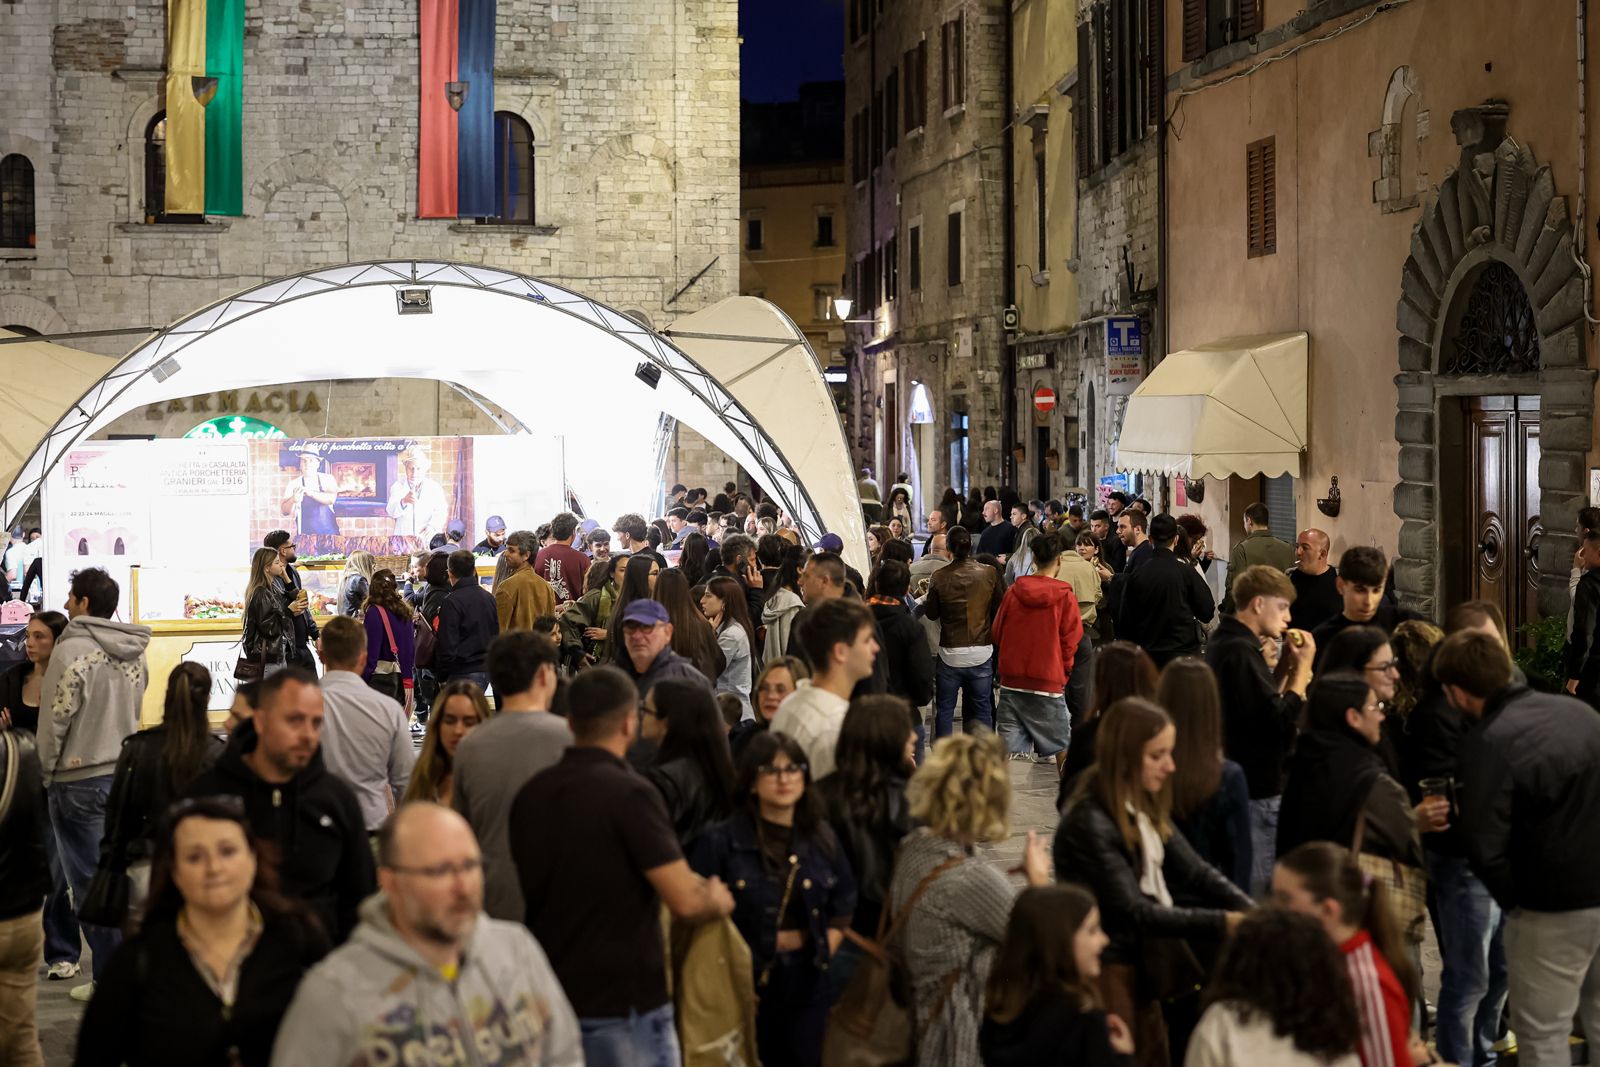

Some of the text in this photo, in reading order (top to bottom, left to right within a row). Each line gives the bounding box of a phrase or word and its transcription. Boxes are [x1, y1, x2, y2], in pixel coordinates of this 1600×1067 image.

[1113, 322, 1135, 346] T
[328, 440, 373, 454] porchetta
[373, 441, 396, 451] cotta
[189, 469, 247, 477] PORCHETTERIA
[221, 476, 243, 485] 1916
